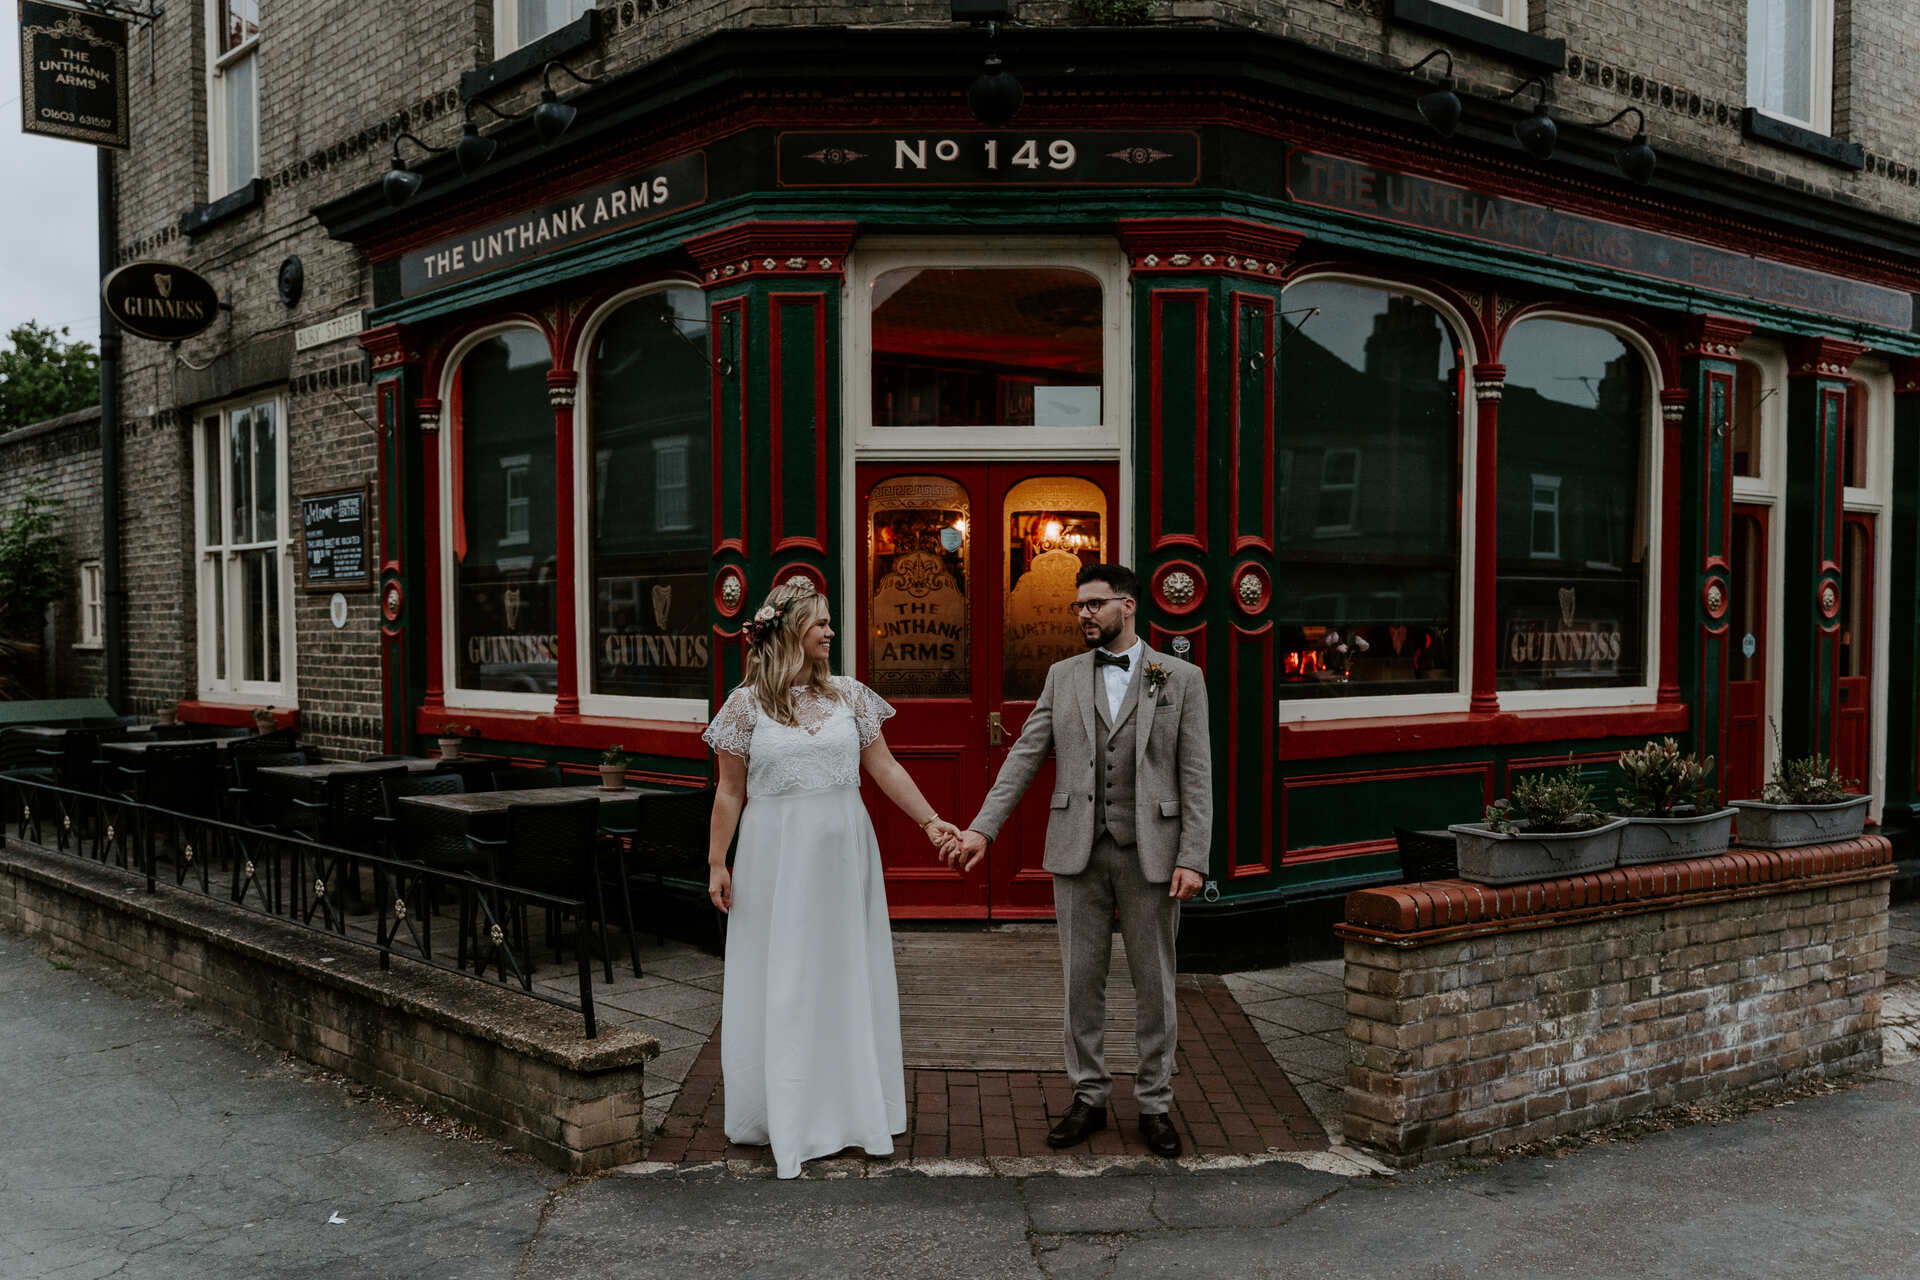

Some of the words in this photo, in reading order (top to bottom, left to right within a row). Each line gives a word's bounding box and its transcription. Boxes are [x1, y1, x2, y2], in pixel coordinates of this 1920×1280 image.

[61, 48, 90, 62] THE
[40, 61, 110, 84] UNTHANK
[56, 73, 96, 90] ARMS
[41, 108, 75, 122] 01603
[984, 139, 1077, 171] 149
[1302, 156, 1377, 208] THE
[1385, 175, 1544, 244] UNTHANK
[1552, 219, 1633, 263] ARMS
[423, 245, 465, 279] THE
[471, 203, 587, 264] UNTHANK
[592, 176, 669, 225] ARMS
[124, 296, 204, 320] GUINNESS
[327, 313, 360, 339] STREET
[894, 602, 942, 616] THE
[468, 635, 558, 665] GUINNESS
[605, 634, 709, 669] GUINNES
[881, 643, 956, 661] ARMS
[1511, 631, 1622, 663] GUINNESS
